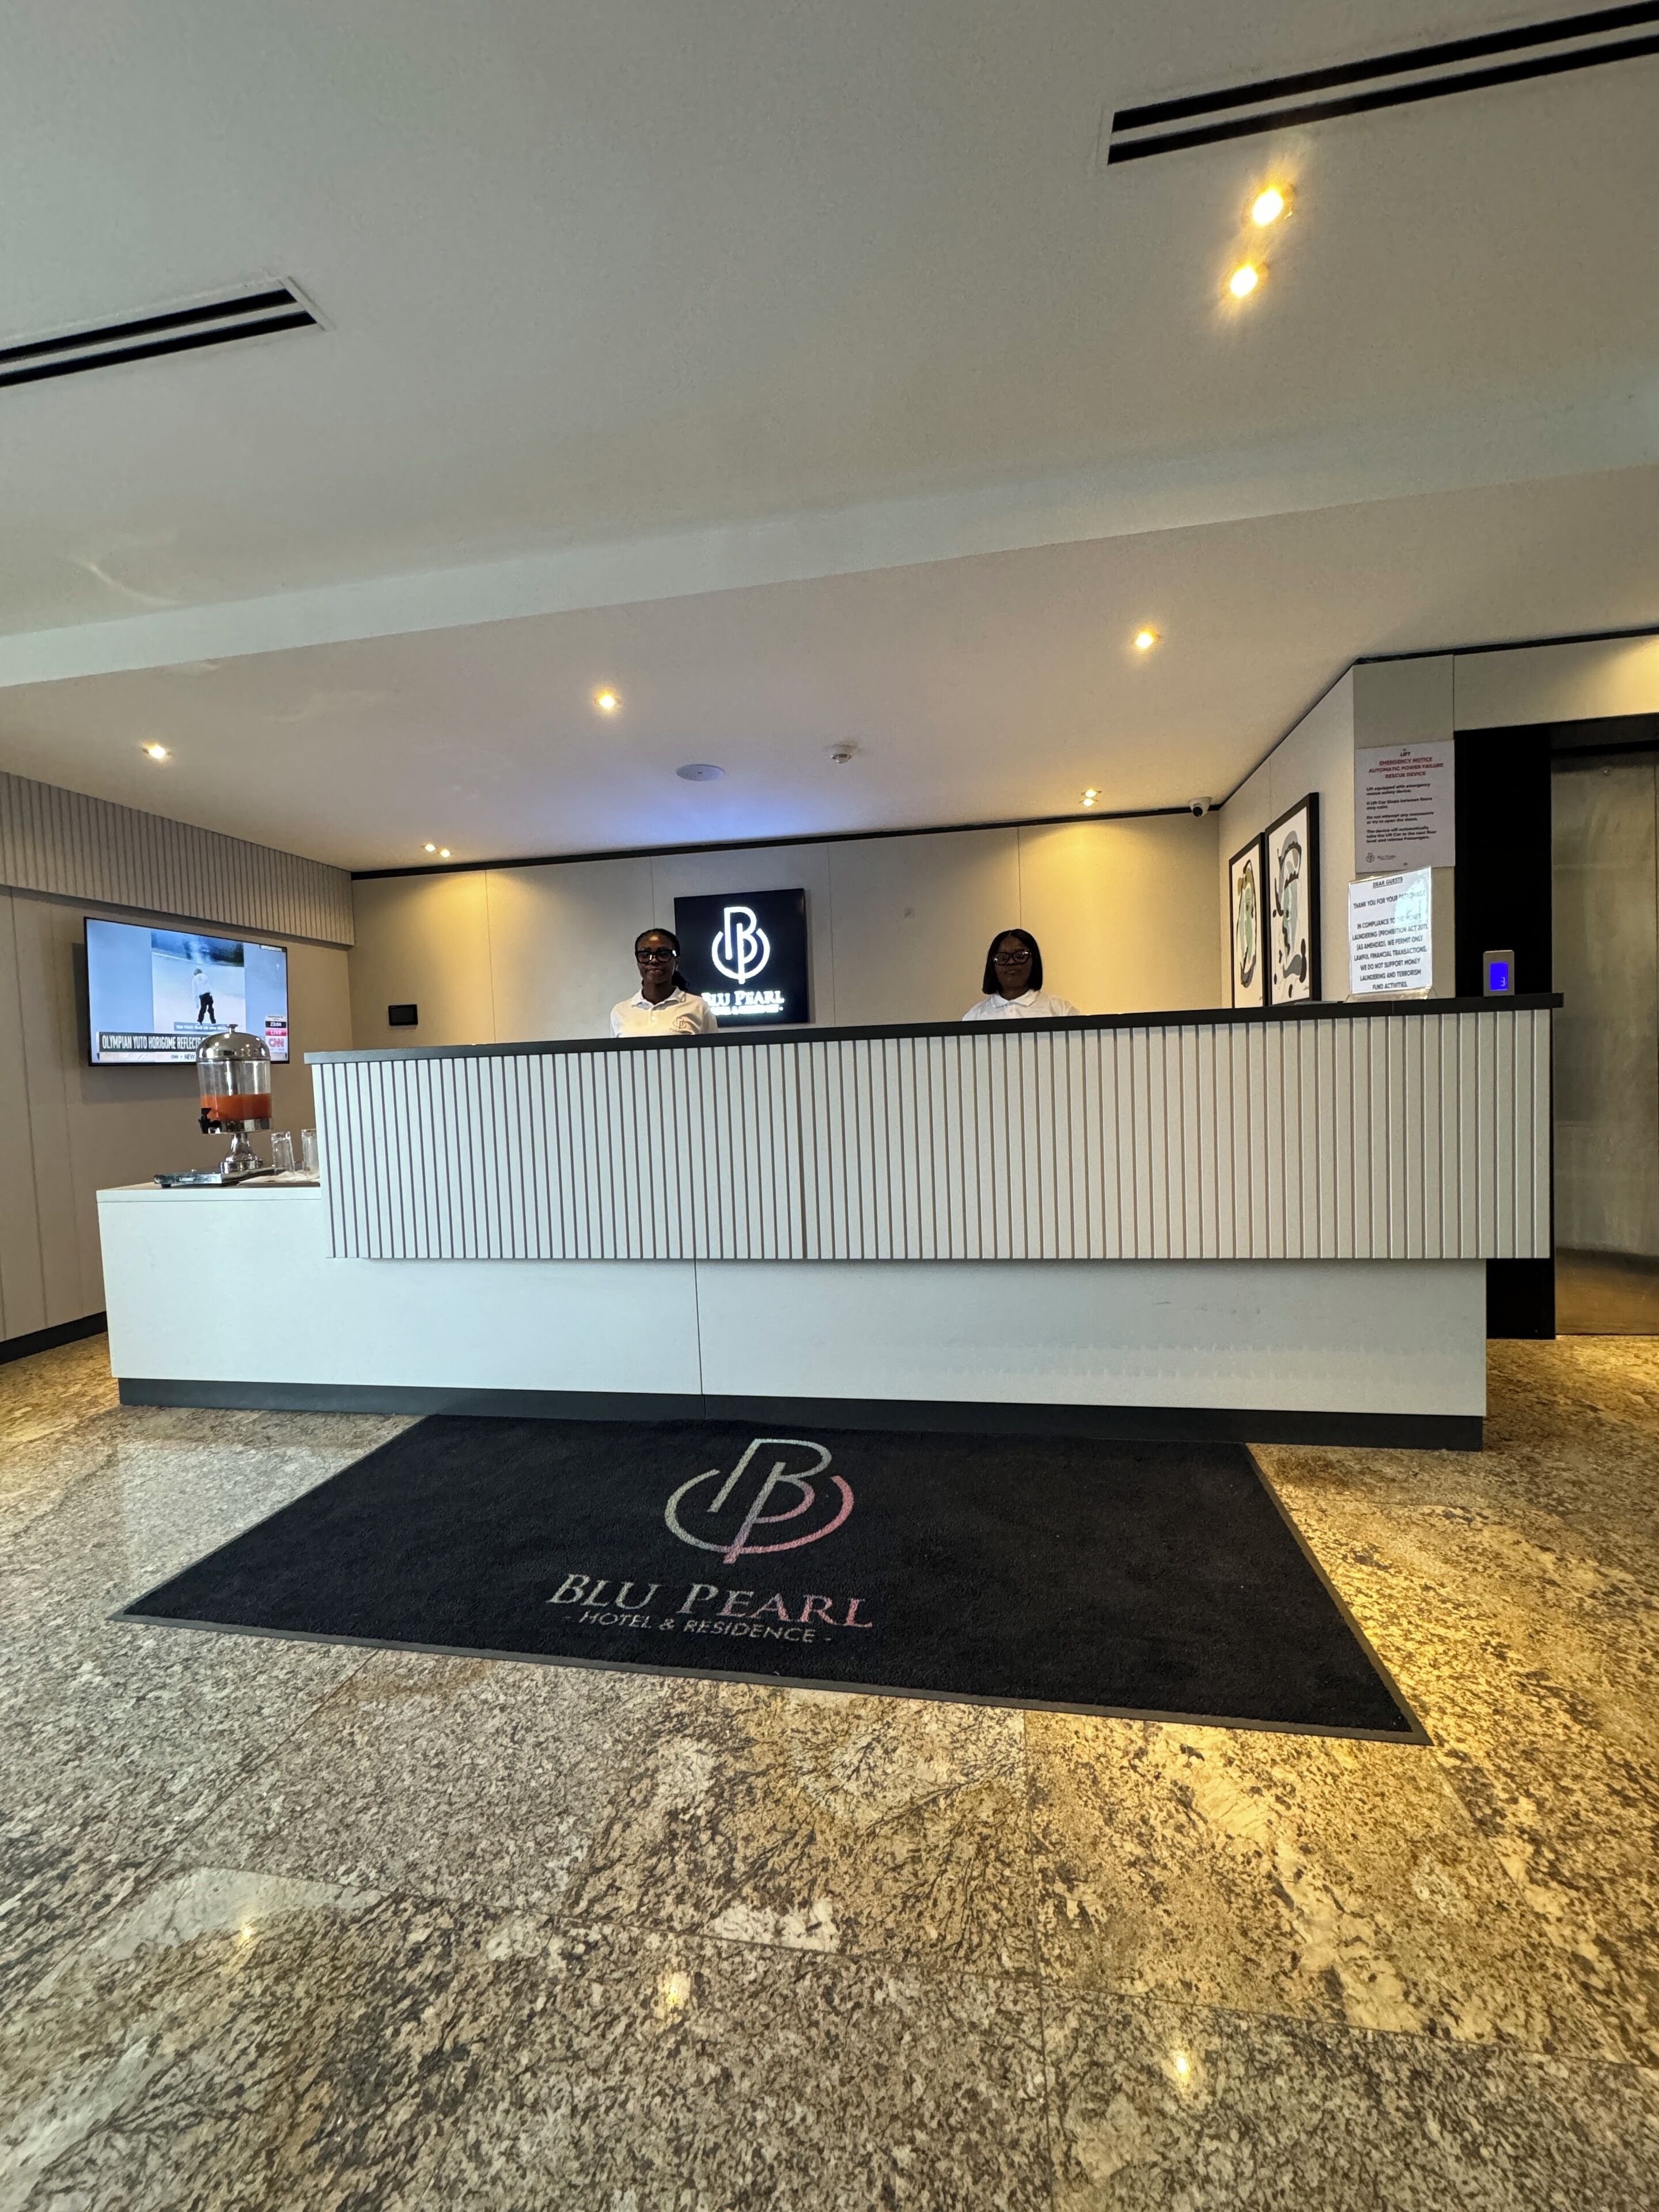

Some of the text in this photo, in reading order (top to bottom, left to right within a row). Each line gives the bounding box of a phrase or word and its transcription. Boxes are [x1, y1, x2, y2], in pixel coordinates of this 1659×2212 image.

[1369, 765, 1400, 773] AUTOMATIC
[1362, 918, 1389, 929] COMPLIANCE
[1352, 931, 1377, 941] LAUNDERING
[1395, 937, 1411, 945] PERMIT
[1370, 950, 1392, 959] FINANCIAL
[1360, 973, 1385, 981] LAUNDERING
[1396, 969, 1421, 978] TERRORISM
[701, 990, 785, 1006] BLU PEARL
[102, 1035, 132, 1049] OLYMPIAN
[133, 1036, 147, 1049] YUTO
[148, 1036, 176, 1050] HORIGOME
[268, 1038, 284, 1047] CNN
[546, 1573, 873, 1627] BLU PEARL
[578, 1611, 652, 1628] HOTEL
[659, 1618, 675, 1631] &
[683, 1619, 817, 1643] RESIDENCE
